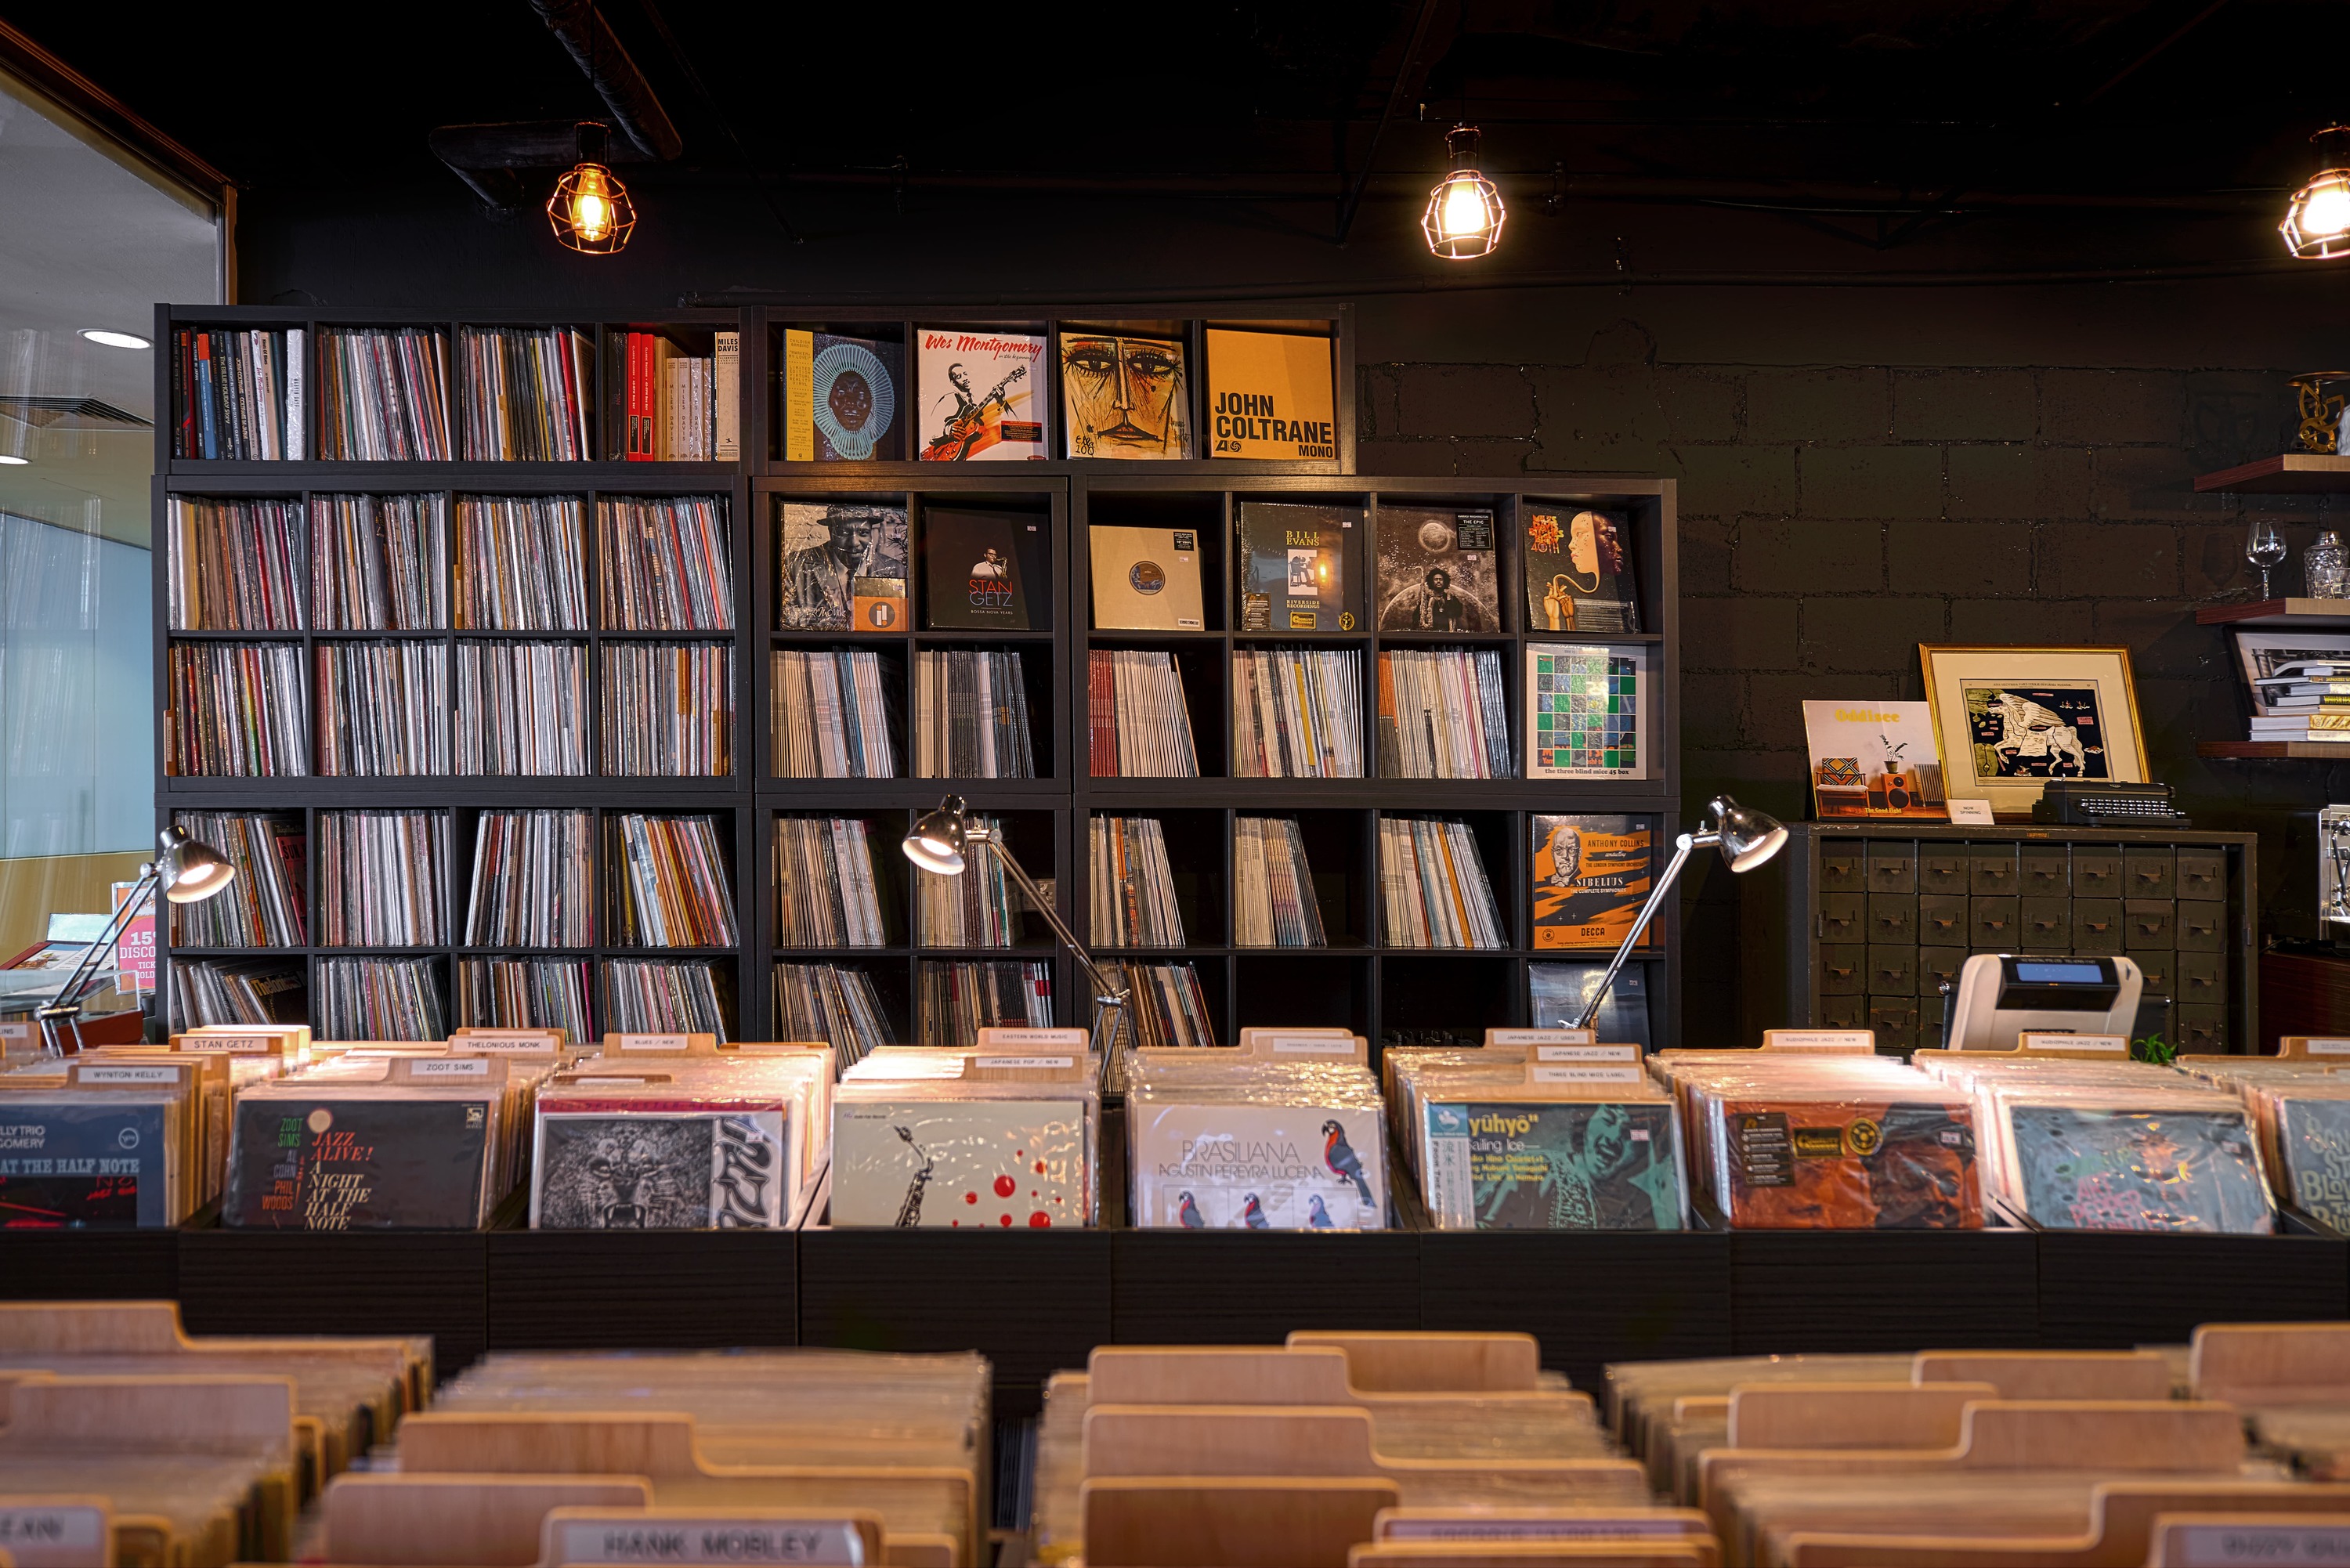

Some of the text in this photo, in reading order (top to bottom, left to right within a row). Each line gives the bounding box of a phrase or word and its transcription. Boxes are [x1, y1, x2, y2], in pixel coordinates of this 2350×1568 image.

[925, 334, 1043, 363] Wes Montgomery
[1215, 392, 1274, 417] JOHN
[1217, 415, 1332, 444] COLTRANE
[1076, 445, 1094, 455] 100
[1298, 444, 1333, 457] MONO
[1286, 530, 1320, 539] BILL
[1531, 542, 1560, 554] 40TH
[969, 580, 1013, 594] STAN
[970, 591, 1013, 606] GETZ
[1835, 709, 1900, 723] Oddisee
[283, 844, 300, 860] SUN
[1576, 877, 1624, 887] SIBELIUS
[1581, 927, 1605, 936] DECCA
[194, 1040, 254, 1049] STAN GETZ
[20, 1125, 45, 1136] TRIO
[280, 1118, 303, 1132] ZOOT
[278, 1133, 301, 1147] SIMS
[312, 1132, 356, 1147] JAZZ
[287, 1149, 298, 1163] AL
[1182, 1140, 1300, 1163] BRASILIANA
[0, 1158, 140, 1173] AT THE HALF NOTE
[273, 1164, 297, 1178] COHN
[309, 1161, 321, 1174] A
[1159, 1163, 1325, 1180] AGUSTIN PEREYRA LUCENA
[274, 1180, 294, 1194] PHIL
[307, 1174, 364, 1188] NIGHT
[306, 1188, 372, 1202] AT THE
[262, 1195, 294, 1210] WOODS
[304, 1202, 352, 1216] HALF
[304, 1216, 352, 1230] NOTE
[603, 1528, 822, 1560] HANK MOBLEY
